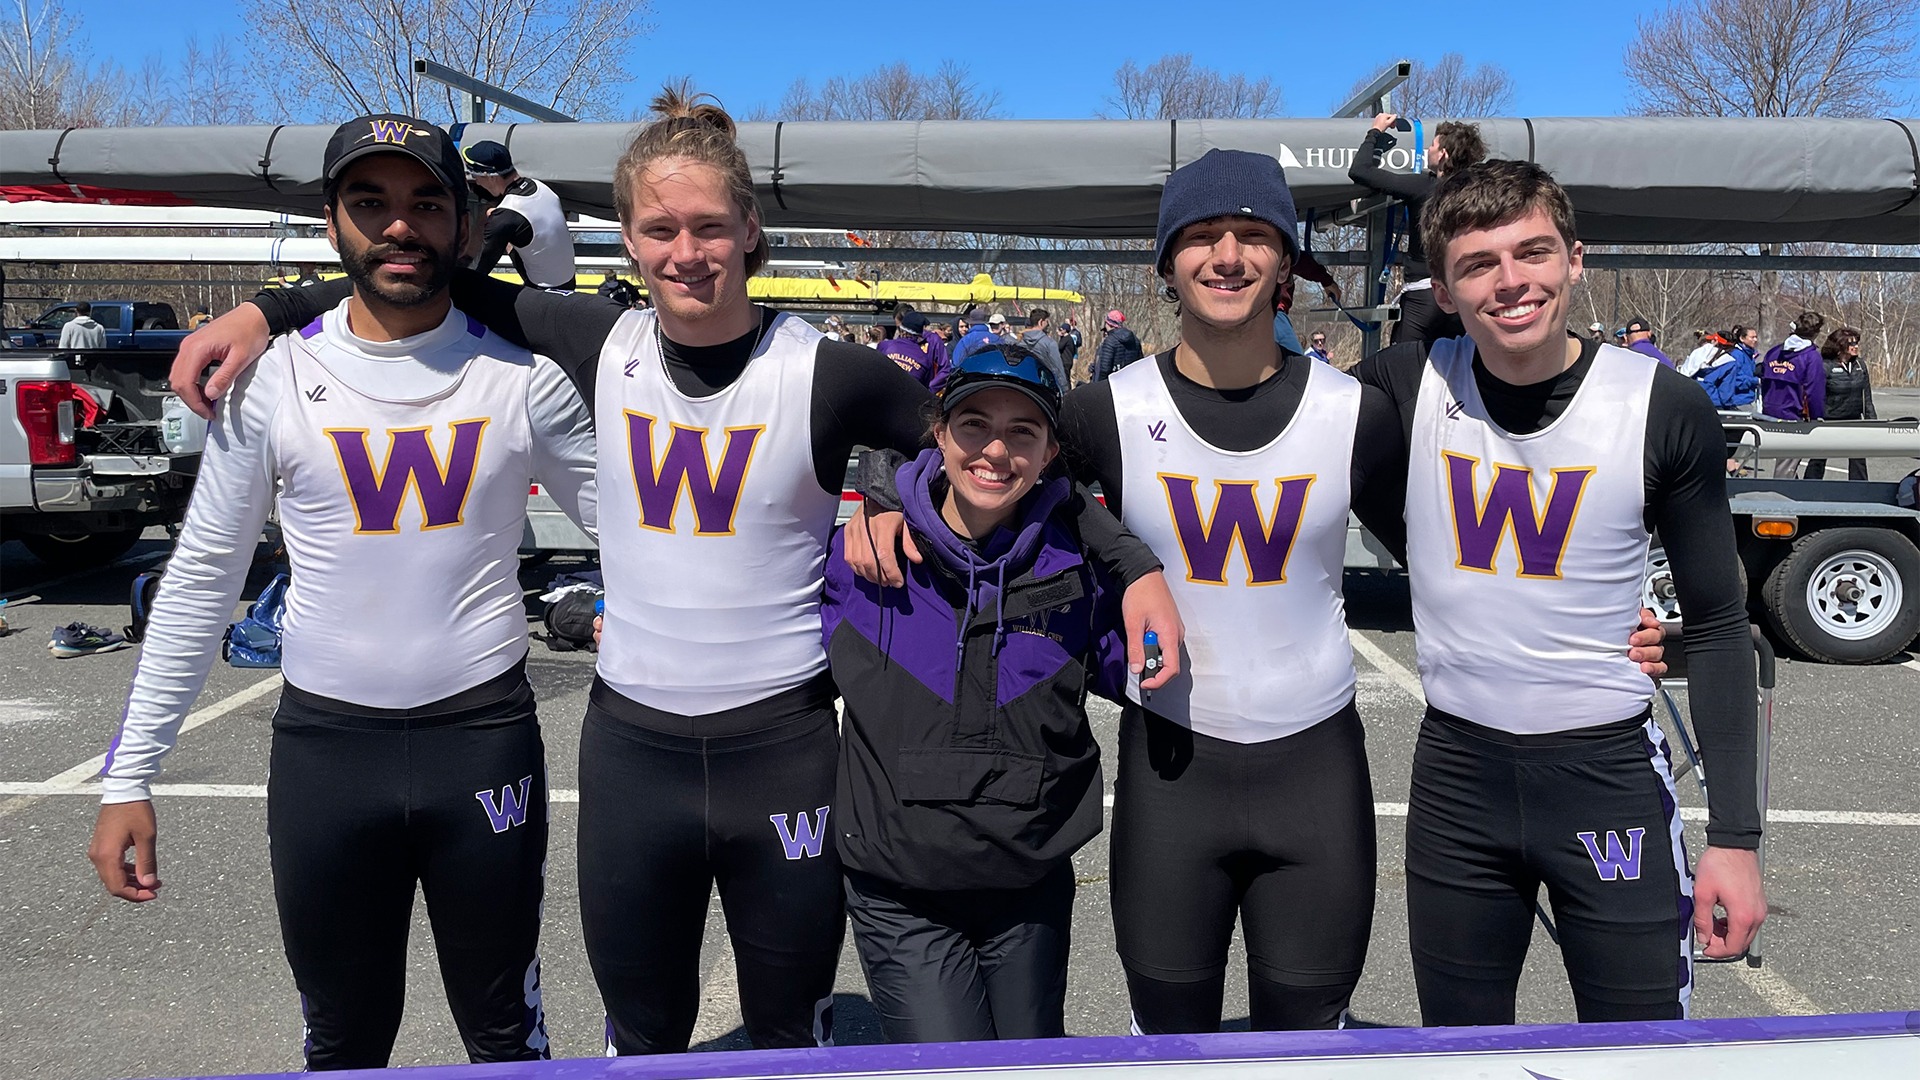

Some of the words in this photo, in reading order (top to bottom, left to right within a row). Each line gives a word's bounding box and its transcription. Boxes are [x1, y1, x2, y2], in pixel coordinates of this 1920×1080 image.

[369, 119, 413, 145] W
[323, 416, 491, 536] W
[623, 408, 766, 537] W
[1441, 450, 1597, 580] W
[1157, 472, 1316, 586] W
[475, 775, 532, 833] W
[770, 805, 830, 860] W
[1577, 827, 1646, 881] W
